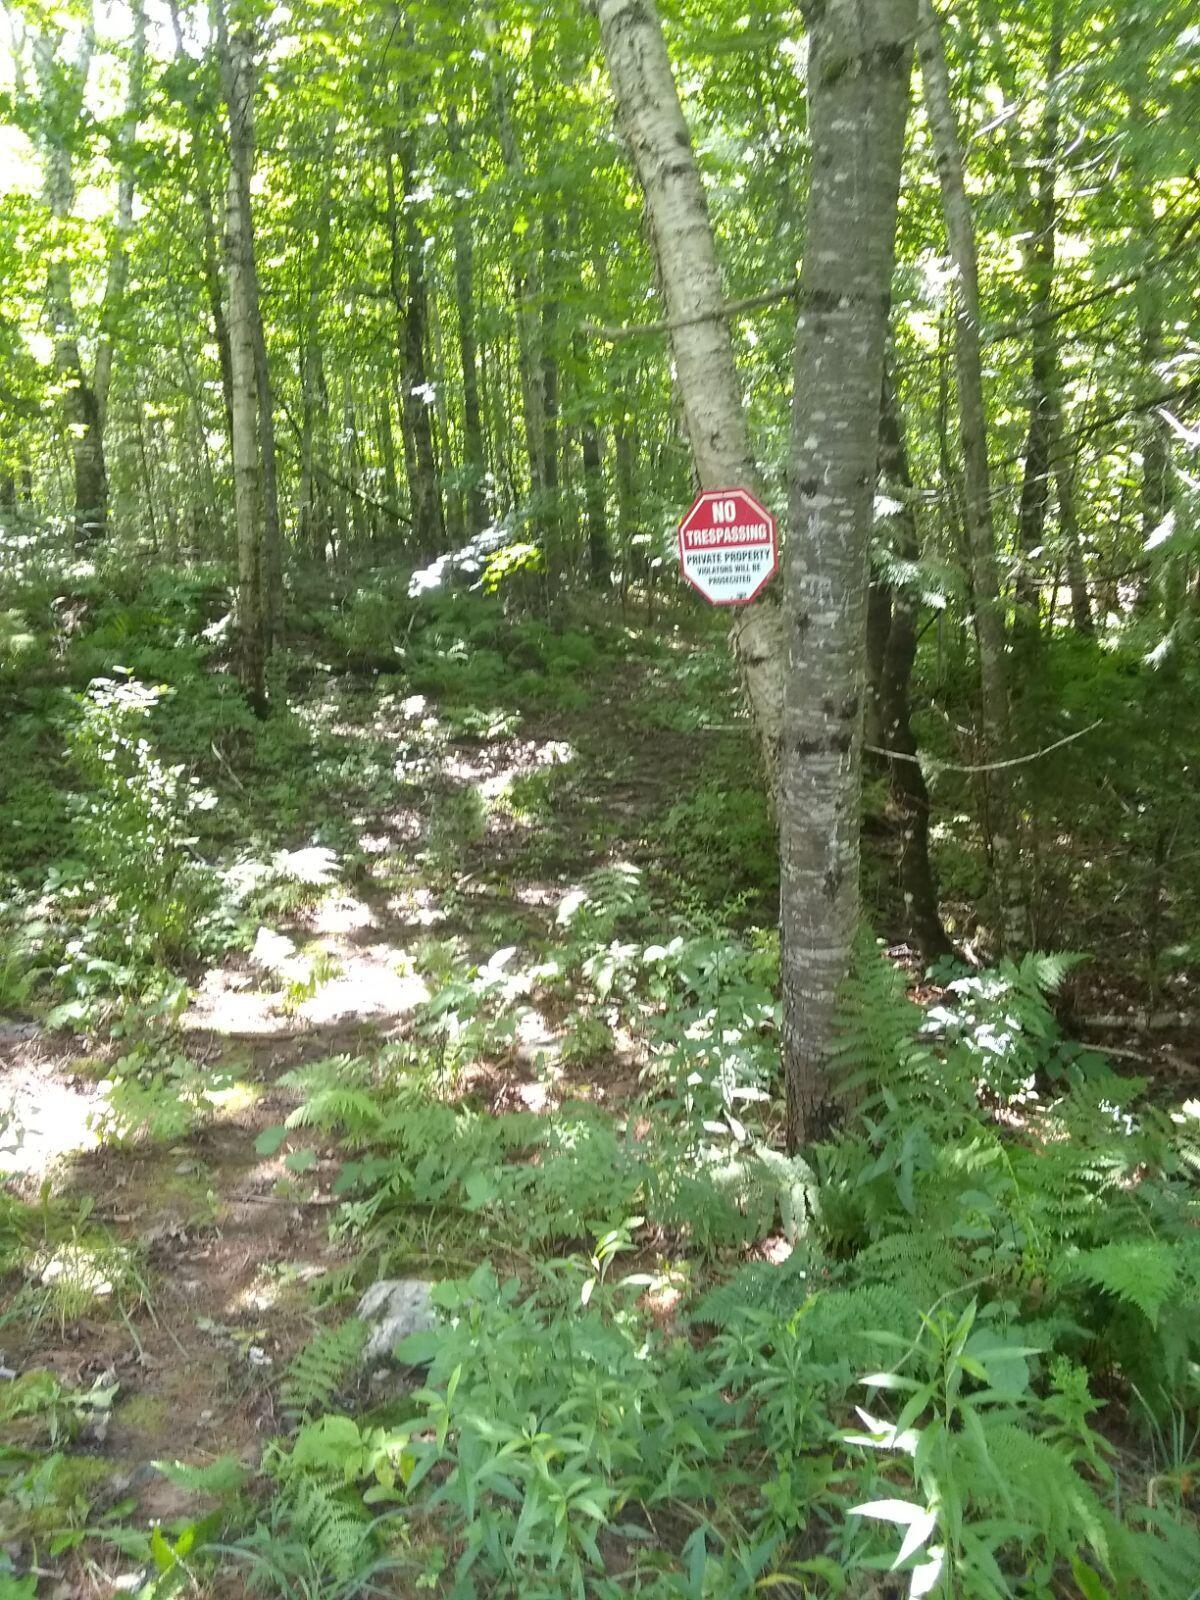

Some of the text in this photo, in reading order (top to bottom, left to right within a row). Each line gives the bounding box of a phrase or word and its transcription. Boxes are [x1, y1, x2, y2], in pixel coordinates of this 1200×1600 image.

[712, 500, 736, 524] NO
[686, 523, 767, 546] TRESPASSING
[686, 548, 770, 565] PRIVATE PROPERTY
[697, 562, 760, 575] VIOLATORS WILL BE
[708, 575, 751, 586] PROSECUTED
